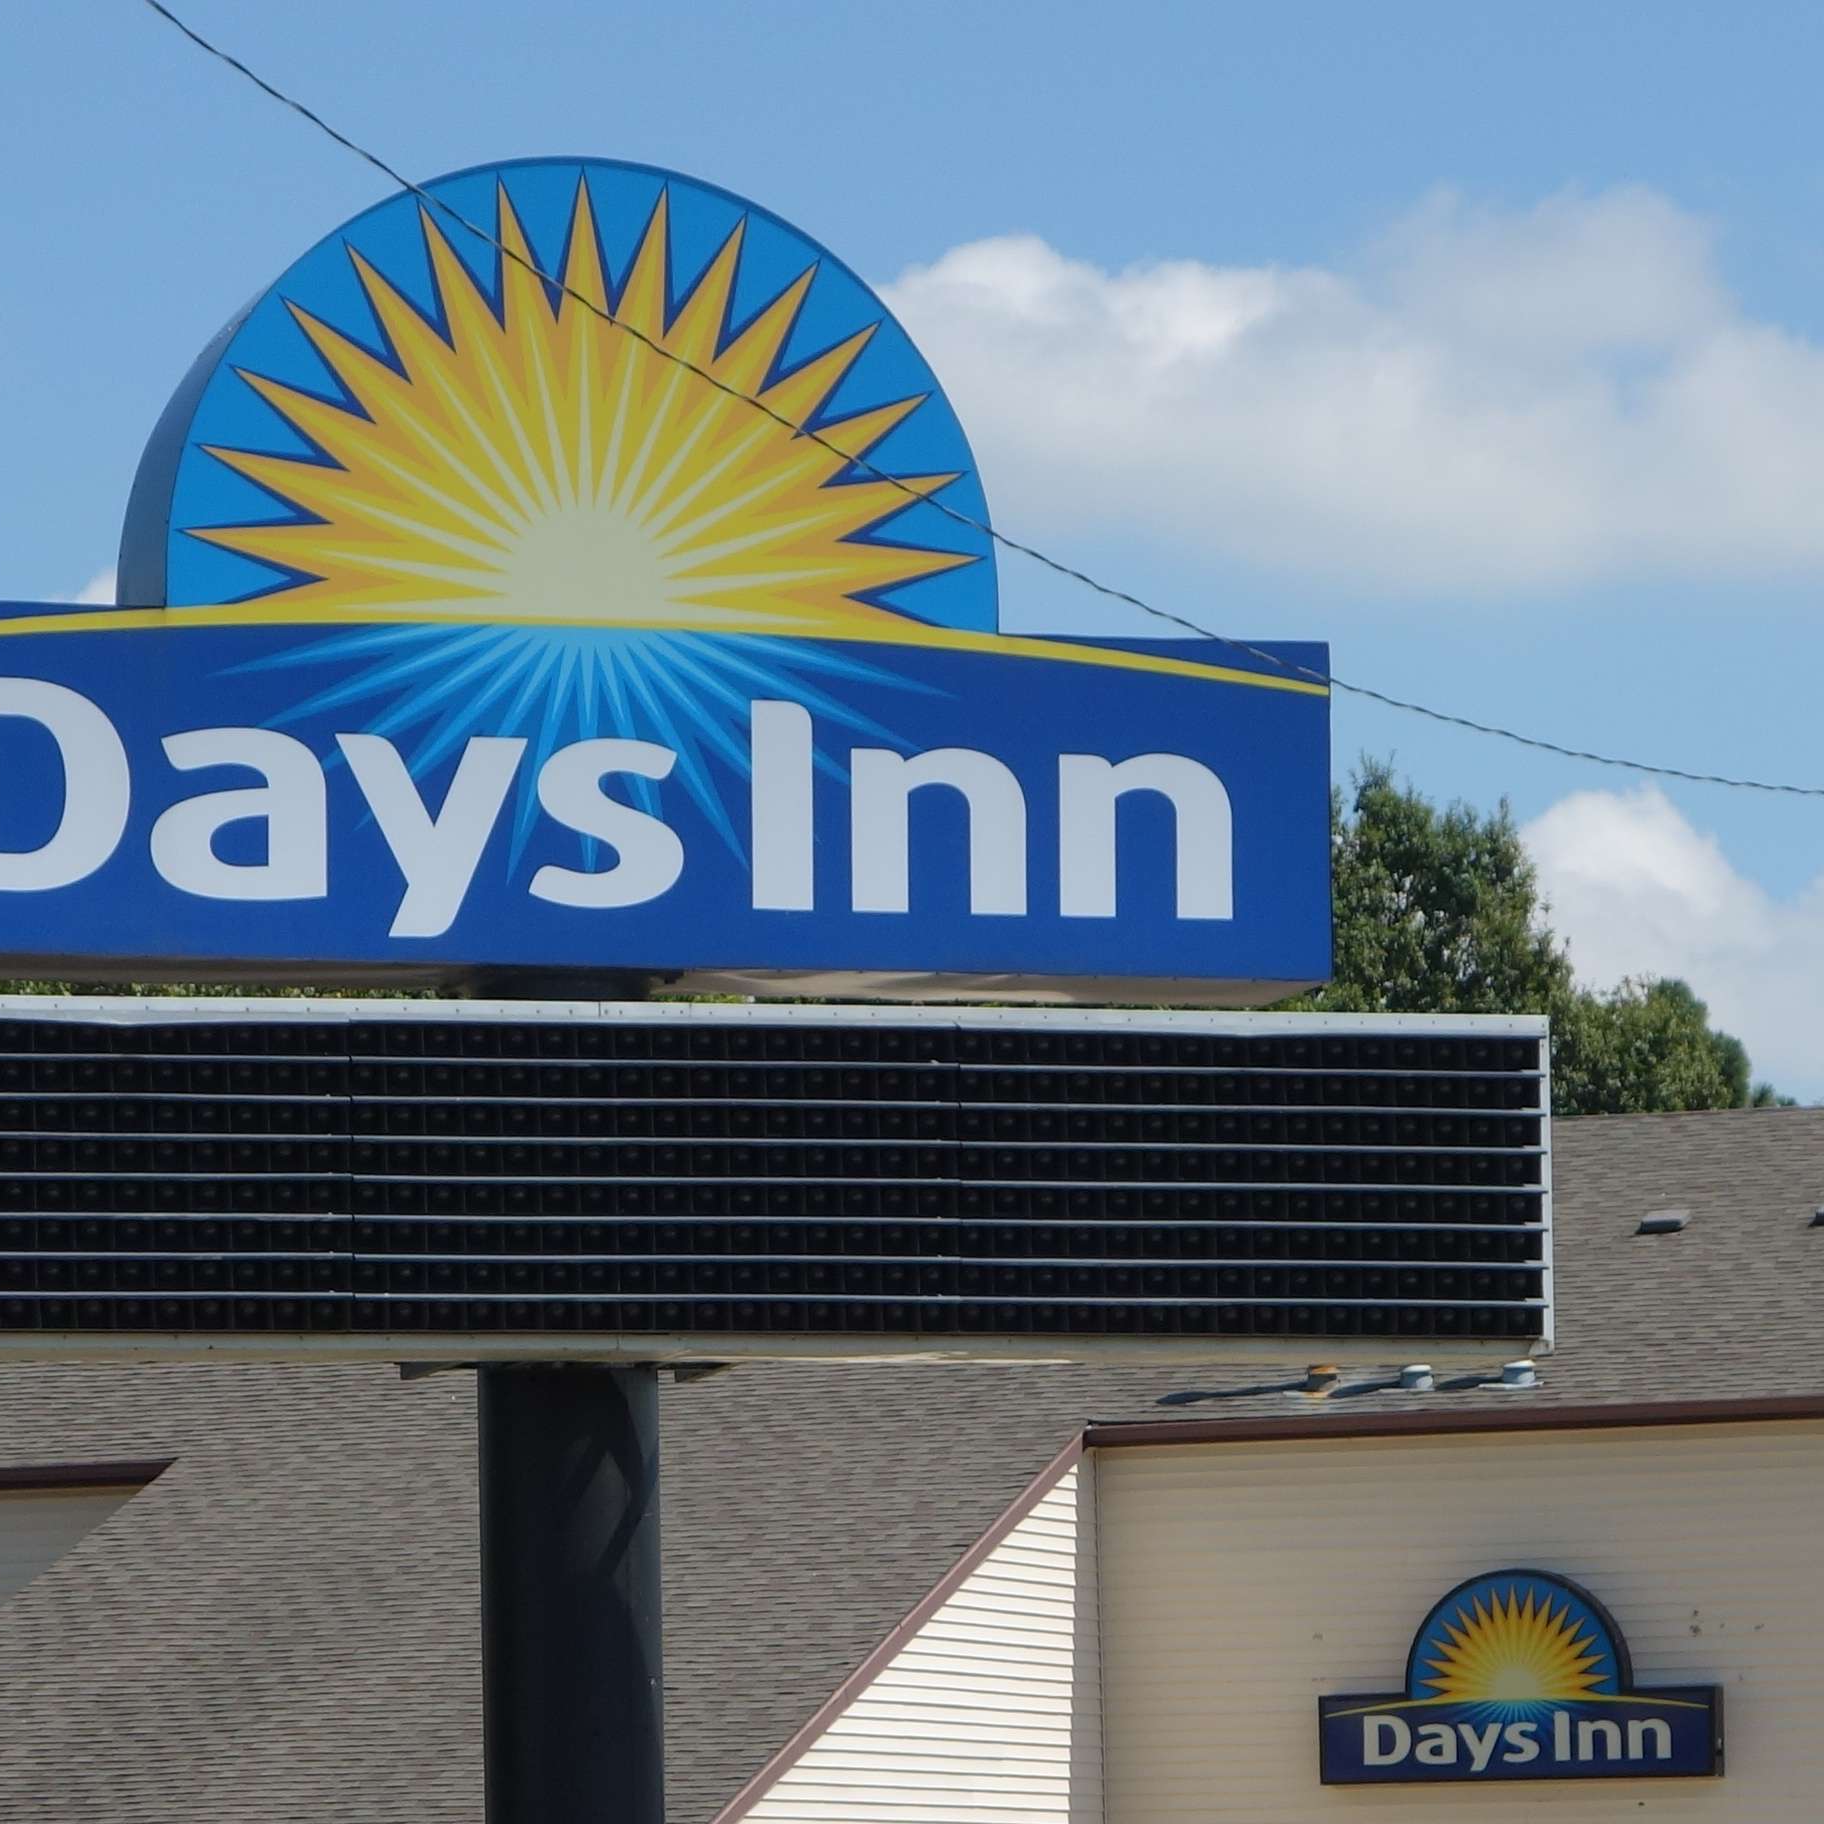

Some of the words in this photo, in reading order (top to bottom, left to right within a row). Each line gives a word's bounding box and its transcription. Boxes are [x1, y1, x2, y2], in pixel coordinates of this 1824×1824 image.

[751, 700, 1234, 920] Inn
[1363, 1715, 1539, 1771] Days
[1553, 1711, 1672, 1762] Inn
